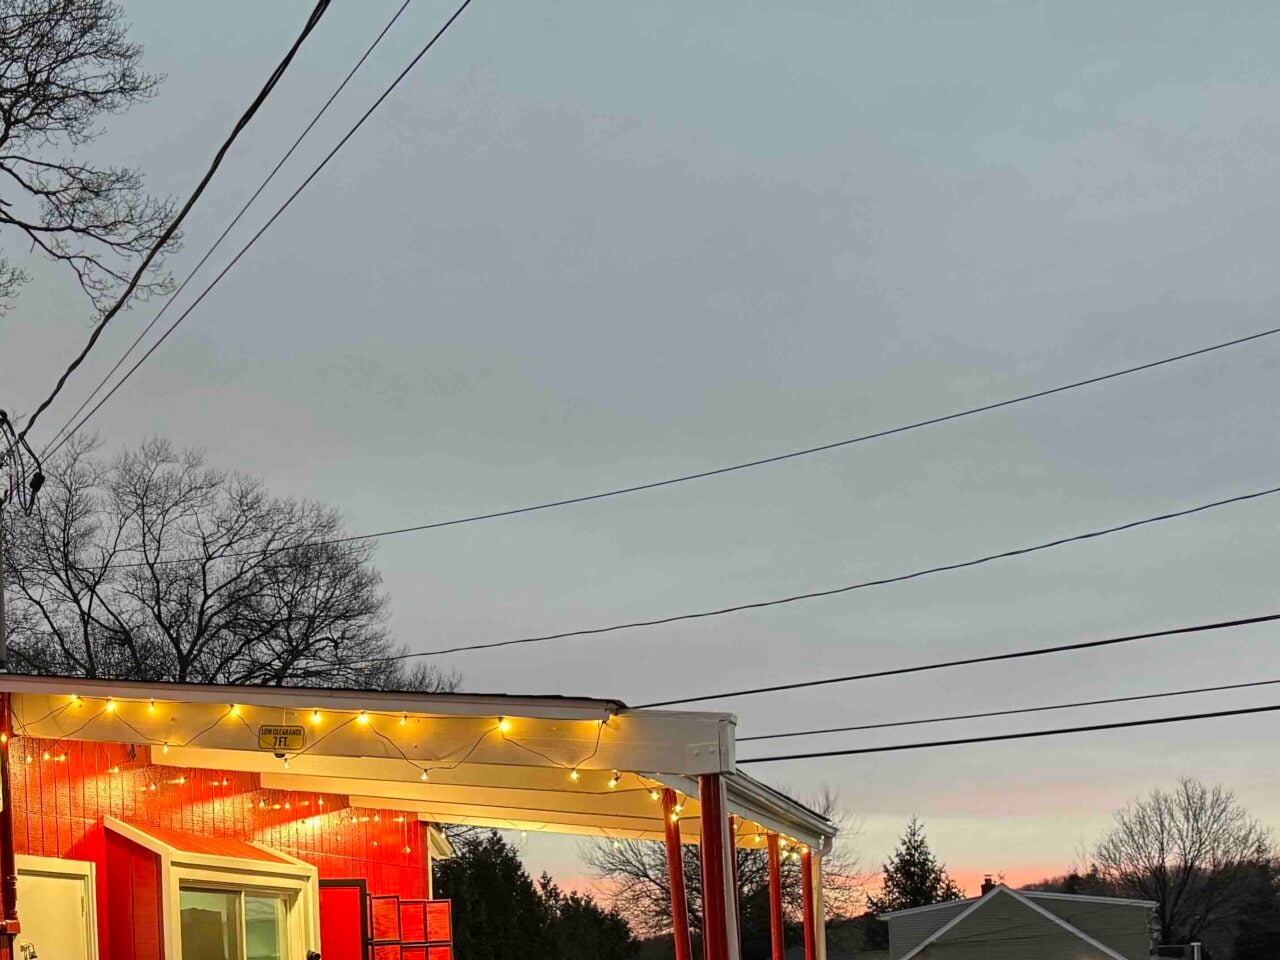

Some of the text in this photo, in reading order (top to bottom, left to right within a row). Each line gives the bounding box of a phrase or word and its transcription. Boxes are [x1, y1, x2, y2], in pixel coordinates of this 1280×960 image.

[261, 728, 302, 736] LOW CLEARANCE
[273, 736, 278, 747] 7
